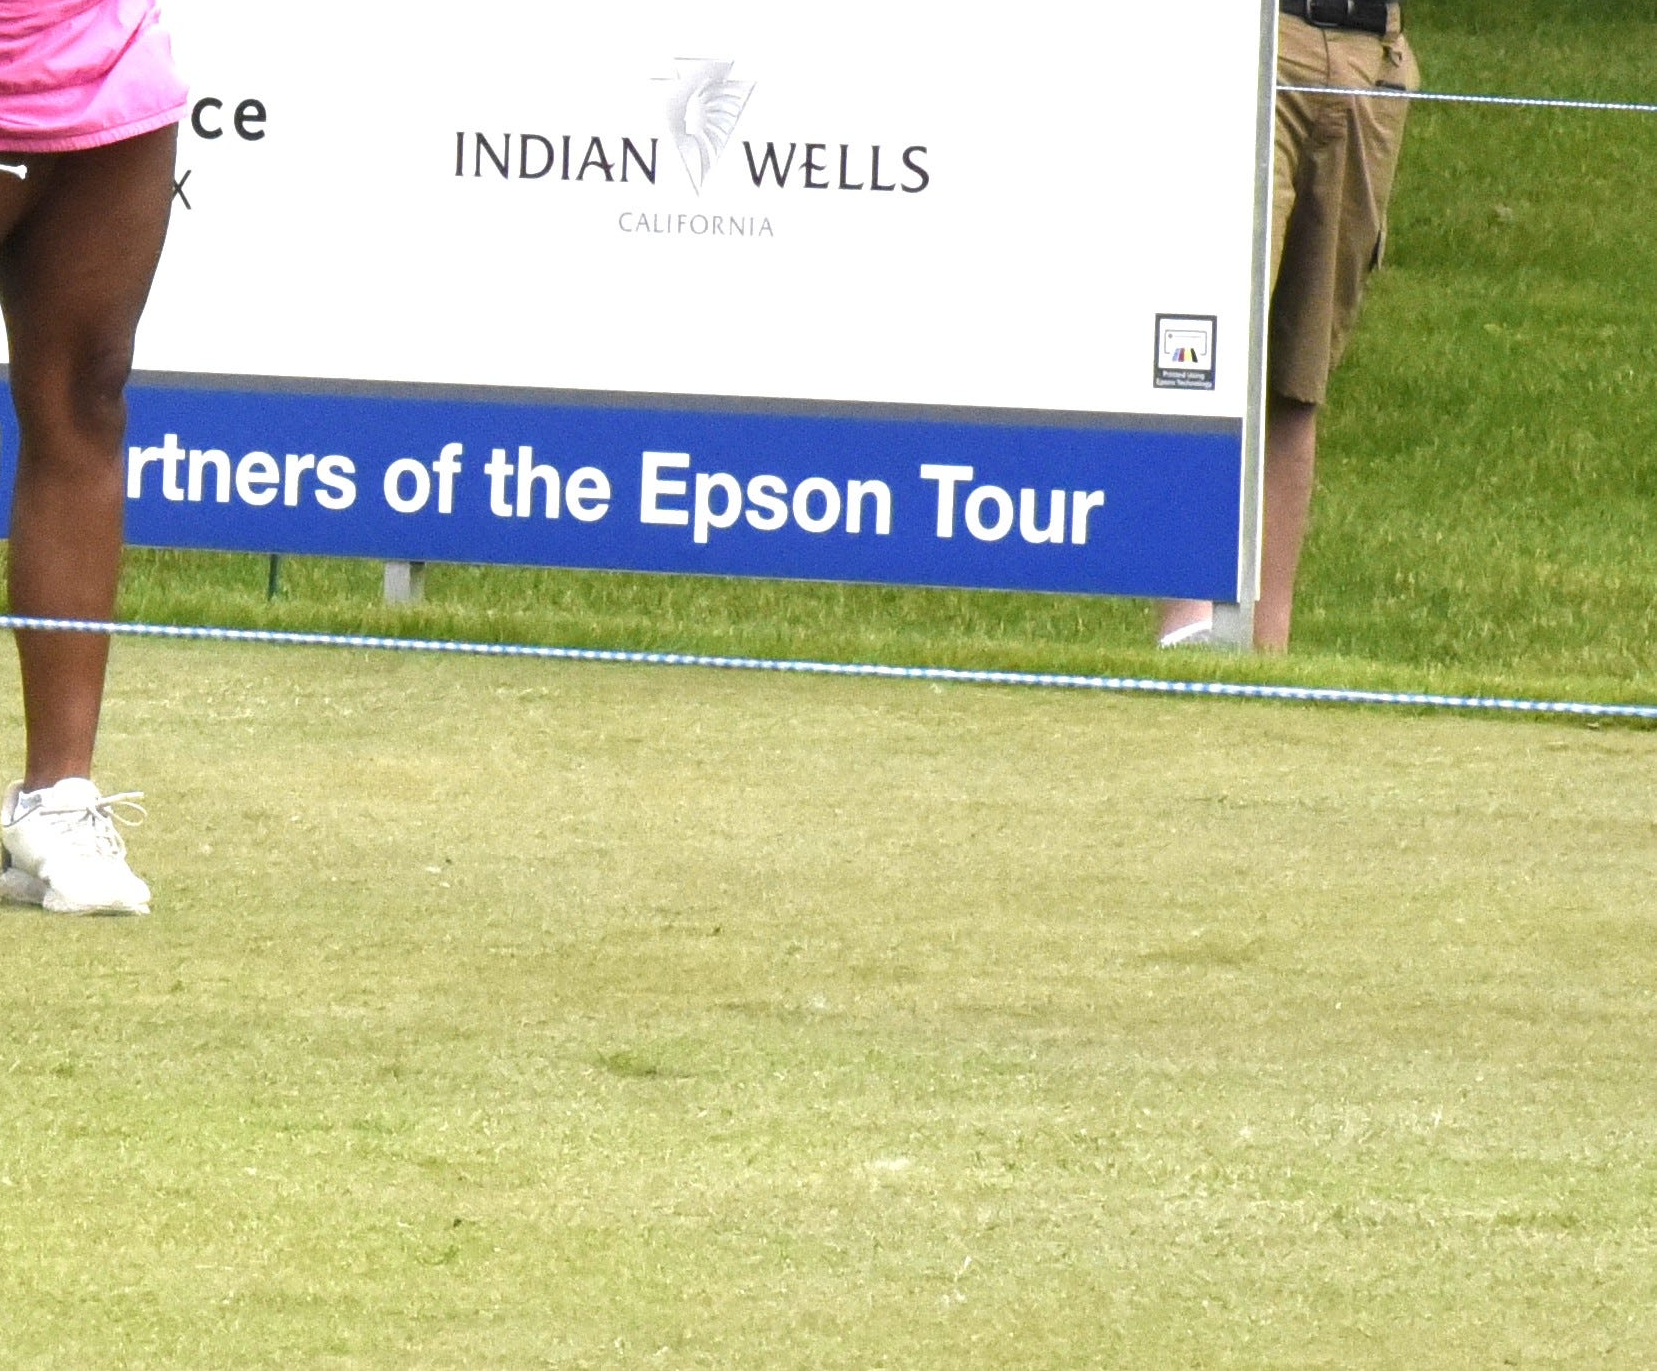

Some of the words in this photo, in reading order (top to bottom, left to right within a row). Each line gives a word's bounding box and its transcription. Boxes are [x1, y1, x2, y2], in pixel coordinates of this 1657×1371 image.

[454, 131, 659, 185] INDIAN
[743, 141, 930, 194] WELLS
[618, 211, 774, 237] CALIFORNIA
[128, 434, 356, 510] rtners
[384, 442, 463, 514] of
[484, 446, 611, 522] the
[640, 451, 892, 544] Epson
[920, 464, 1105, 545] Tour
